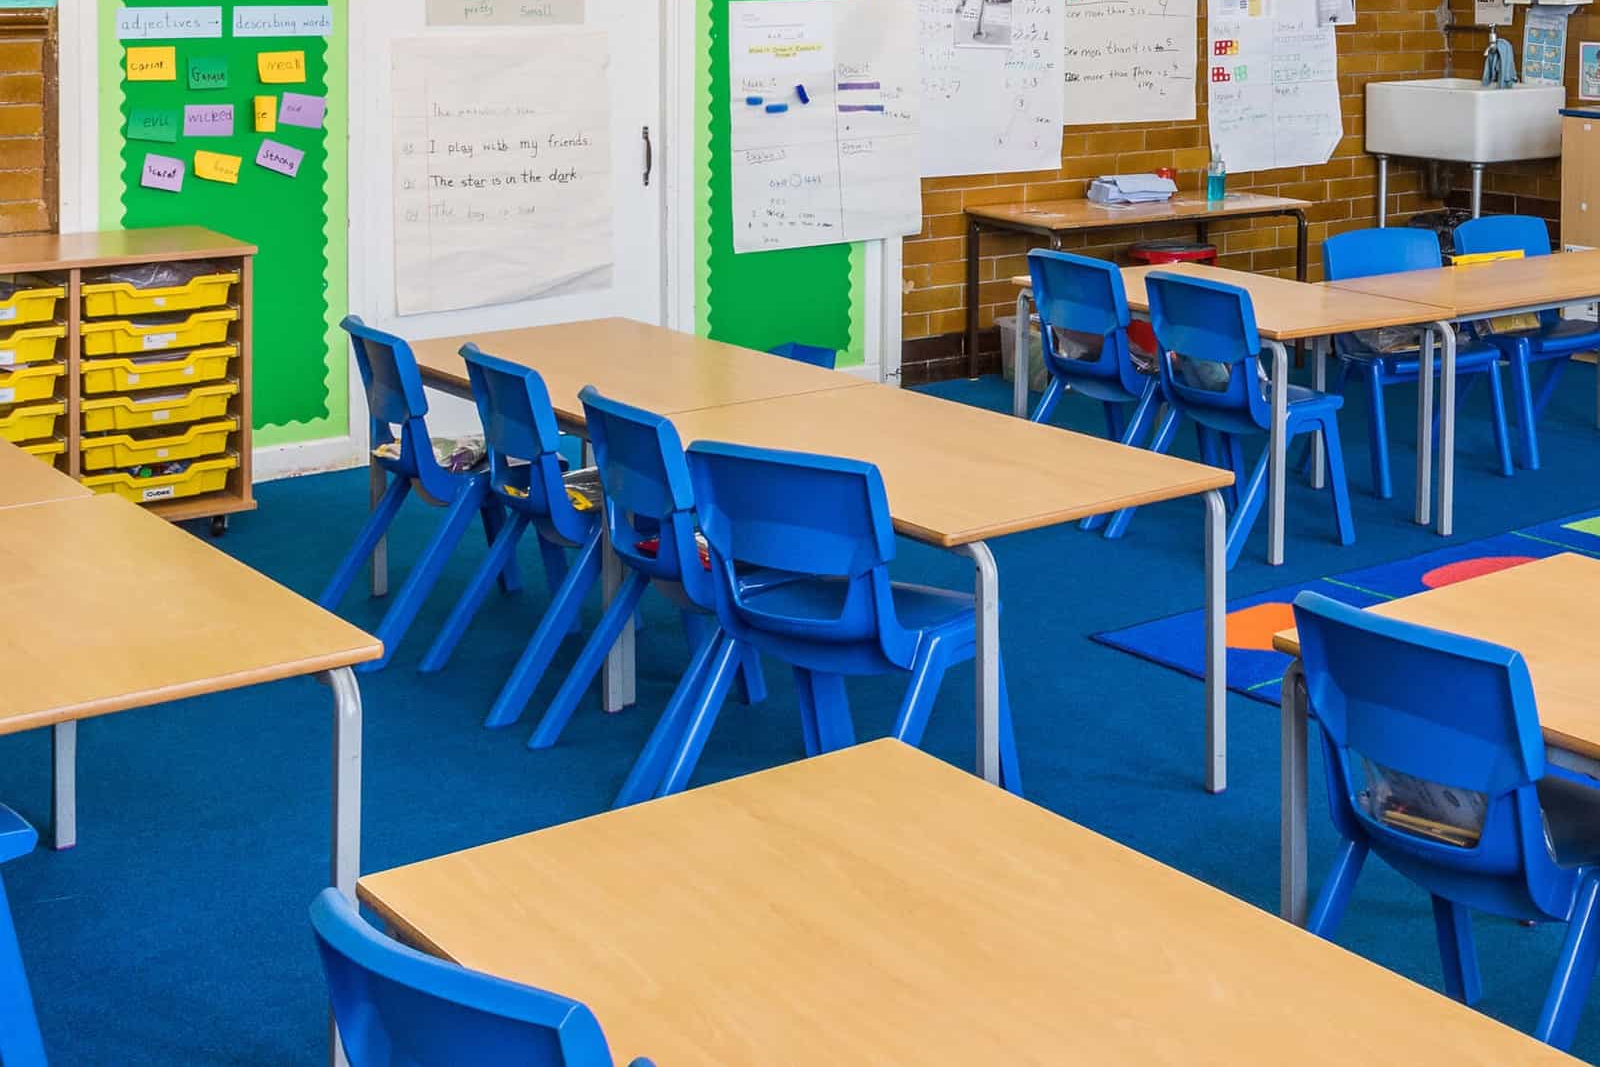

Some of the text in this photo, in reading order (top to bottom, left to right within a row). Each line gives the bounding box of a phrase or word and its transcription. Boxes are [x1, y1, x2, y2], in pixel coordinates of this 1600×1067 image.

[121, 12, 201, 36] adjectives
[236, 13, 330, 34] describing words
[428, 140, 436, 154] I
[448, 142, 474, 158] play
[482, 138, 510, 152] with
[520, 140, 538, 158] my
[430, 174, 454, 188] The
[461, 174, 486, 188] star
[491, 178, 502, 186] is
[506, 176, 517, 185] in
[520, 170, 542, 183] the
